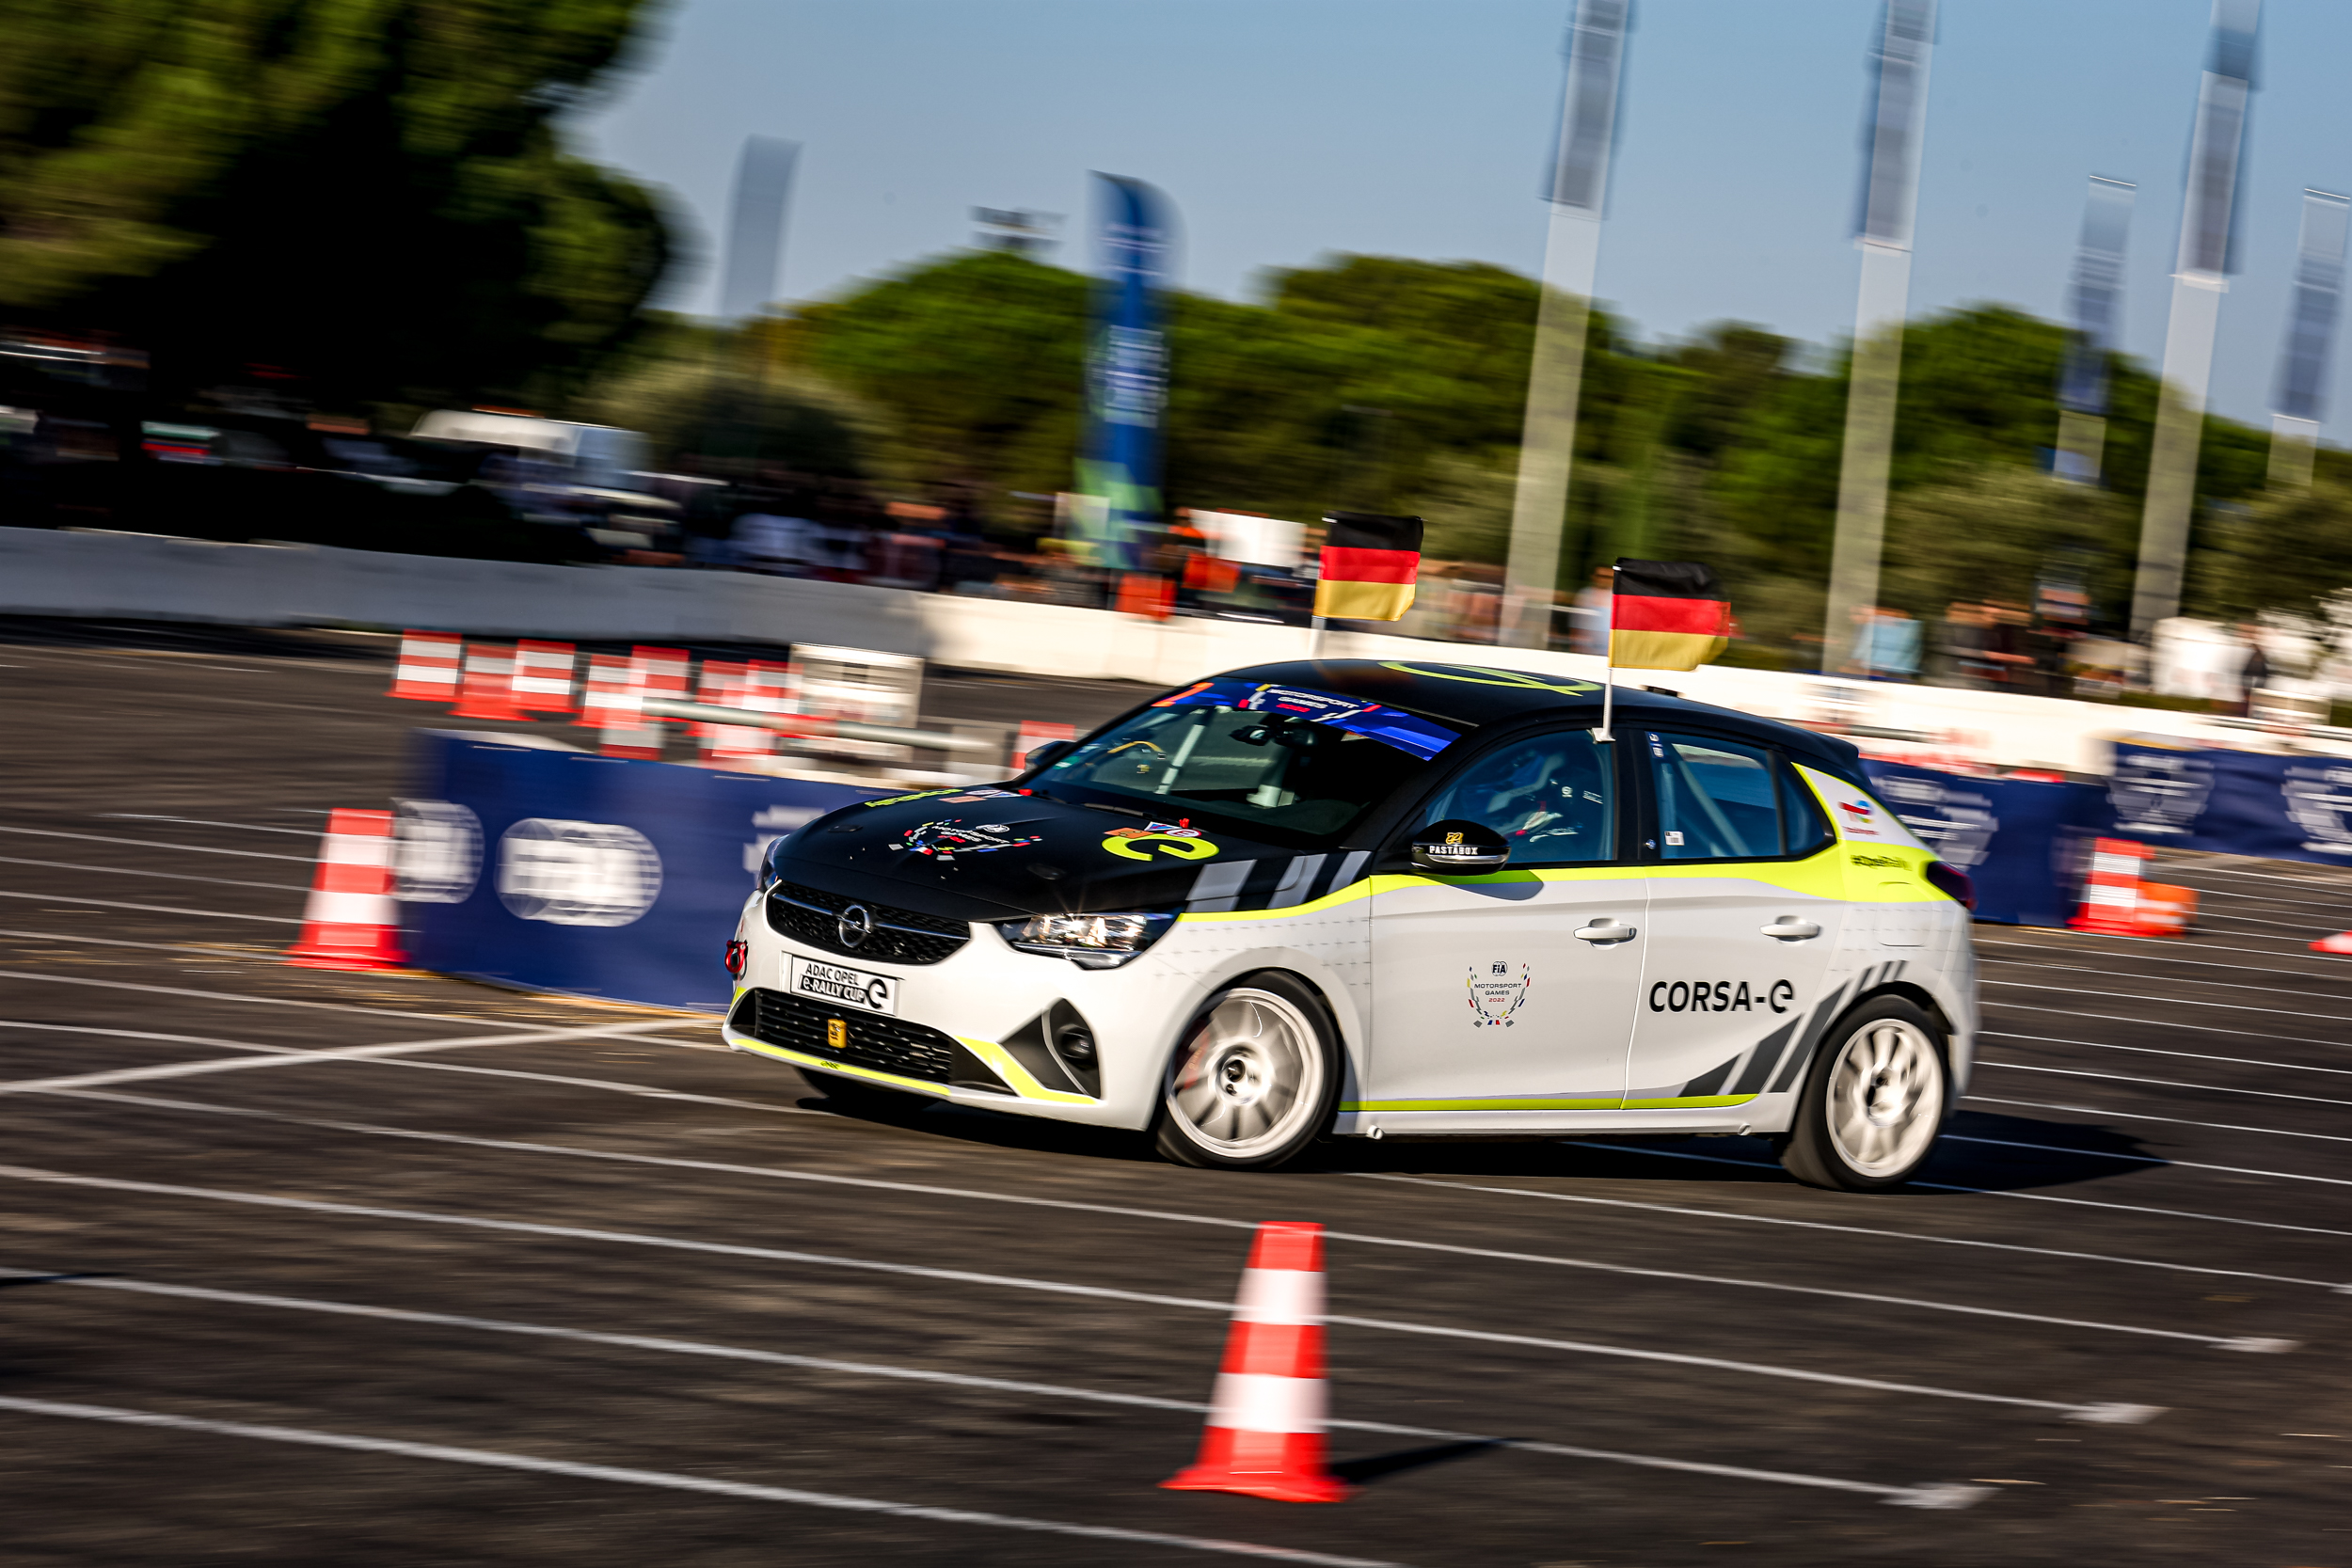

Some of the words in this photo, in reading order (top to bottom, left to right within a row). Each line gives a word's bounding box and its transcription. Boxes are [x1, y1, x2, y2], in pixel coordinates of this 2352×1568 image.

[1429, 845, 1479, 856] PASTABOX
[805, 962, 834, 980] ADAC
[834, 970, 859, 986] OPEL
[803, 975, 843, 998] e-RALLY
[843, 986, 866, 1002] CUP
[1649, 979, 1795, 1014] CORSA-e
